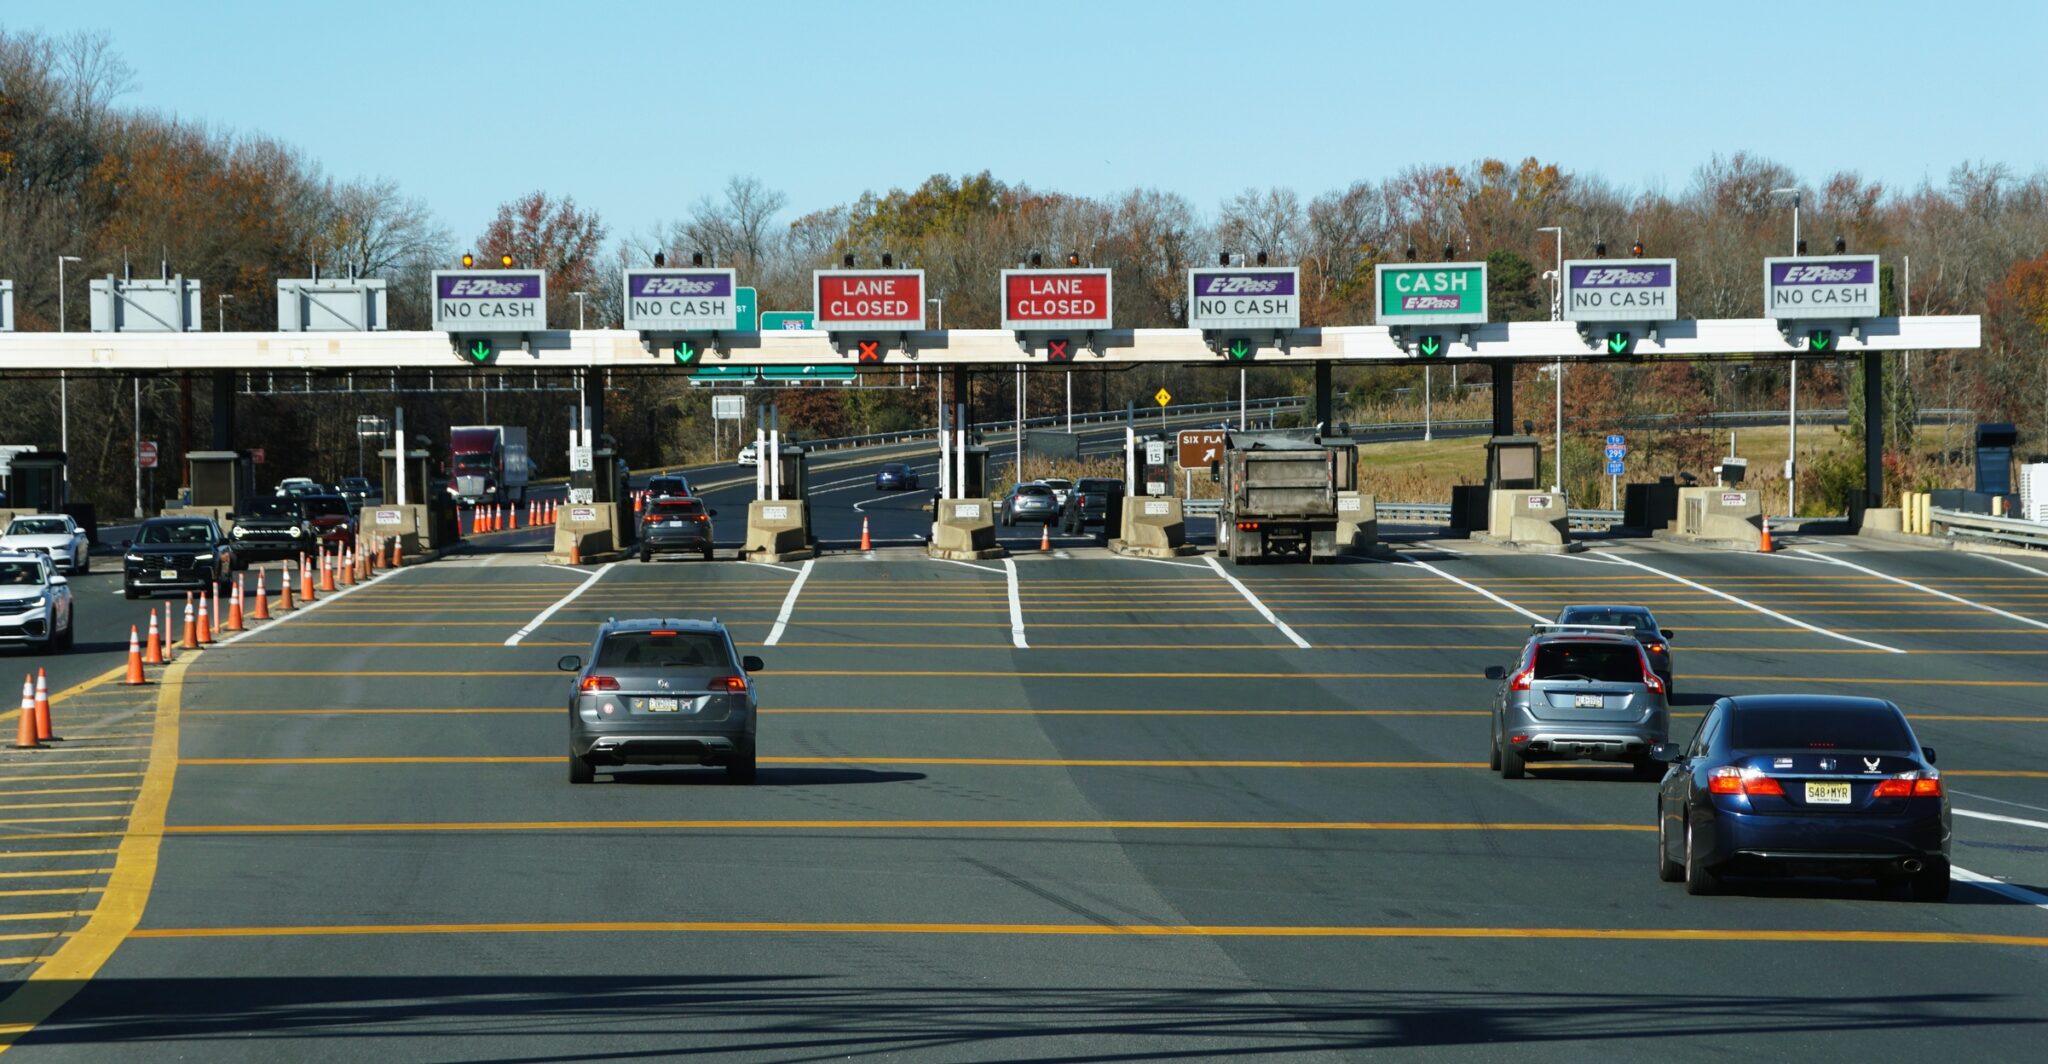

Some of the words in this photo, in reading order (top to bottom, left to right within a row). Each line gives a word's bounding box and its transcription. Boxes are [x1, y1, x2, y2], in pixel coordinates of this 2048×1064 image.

[843, 280, 895, 296] LANE
[1030, 279, 1082, 295] LANE
[1396, 272, 1467, 292] CASH
[1576, 292, 1600, 307] NO
[1610, 291, 1665, 306] CASH
[1777, 289, 1803, 304] NO
[1811, 288, 1867, 304] CASH
[444, 302, 471, 318] NO
[479, 302, 534, 317] CASH
[636, 301, 662, 316] NO
[670, 300, 725, 315] CASH
[831, 301, 908, 316] CLOSED
[1018, 300, 1096, 315] CLOSED
[1201, 300, 1226, 315] NO
[1234, 300, 1288, 314] CASH
[1183, 436, 1199, 444] SIX
[1150, 453, 1161, 462] 15
[1609, 450, 1623, 458] 295
[578, 459, 589, 468] 15
